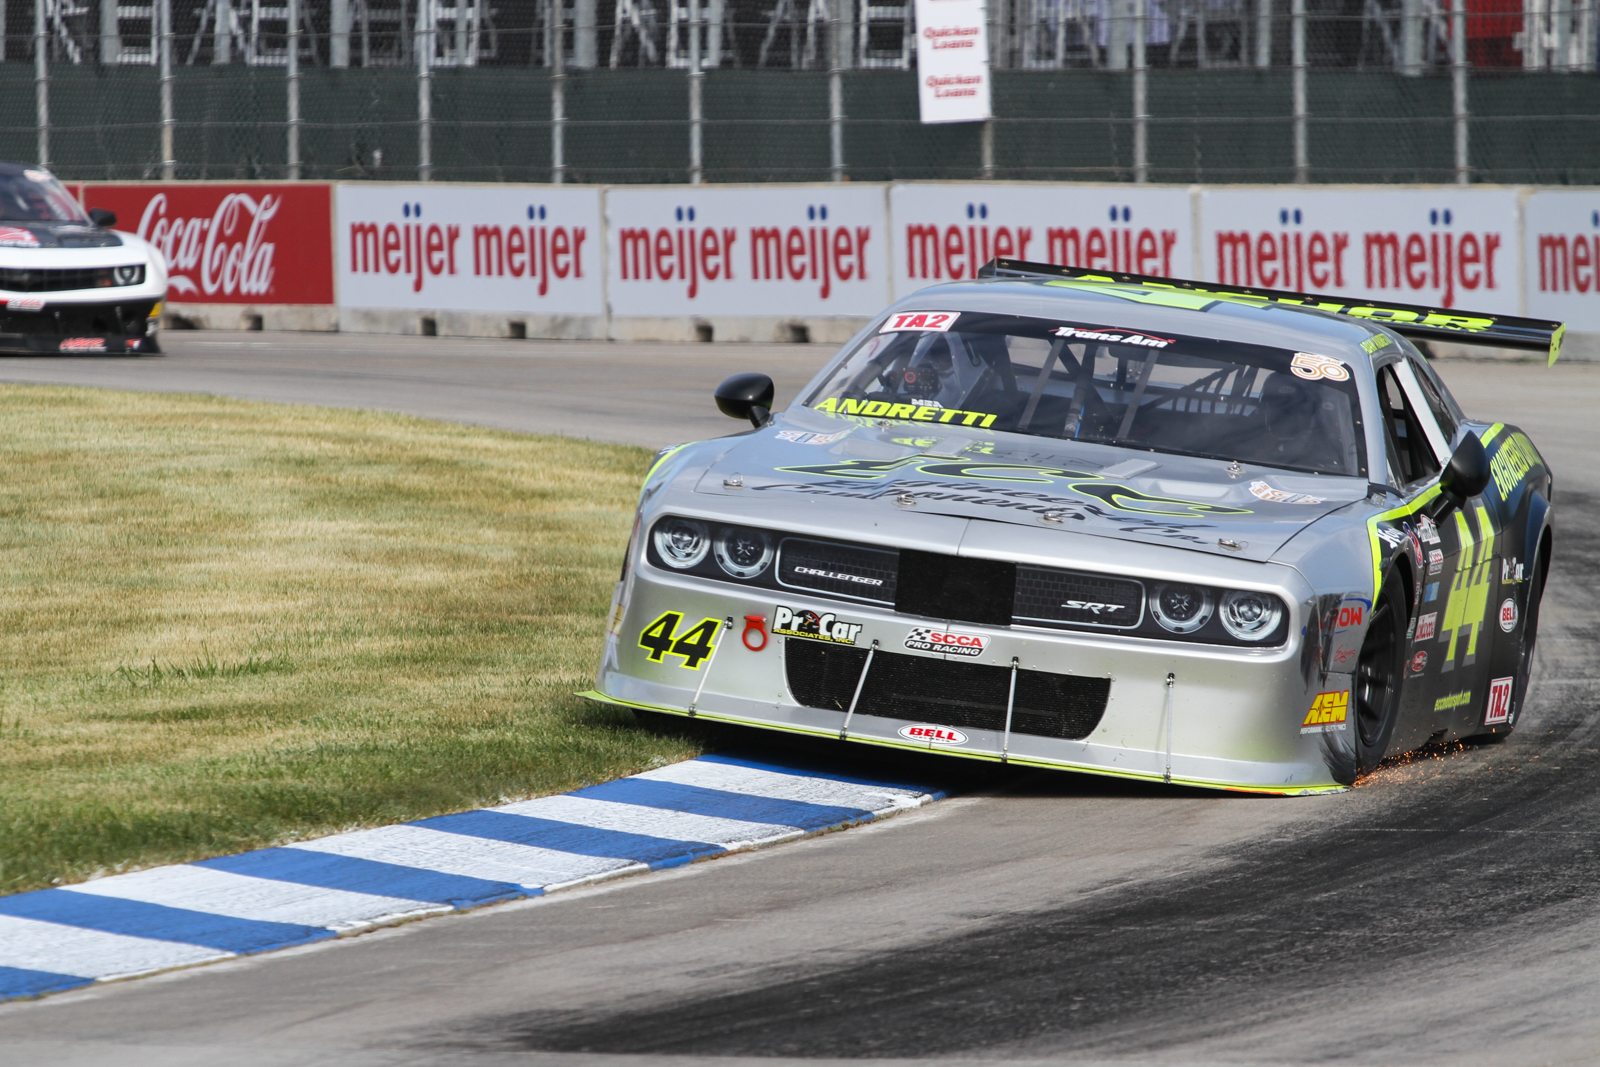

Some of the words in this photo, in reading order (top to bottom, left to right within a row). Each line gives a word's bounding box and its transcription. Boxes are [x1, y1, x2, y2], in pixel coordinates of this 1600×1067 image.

[350, 203, 460, 293] meijer
[473, 205, 586, 296] meijer
[619, 206, 736, 299] meijer
[750, 204, 870, 299] meijer
[1215, 209, 1348, 293] meijer
[1364, 209, 1500, 309] meijer
[893, 314, 950, 328] TA2
[1055, 326, 1123, 341] Trans
[1121, 335, 1168, 348] Am
[814, 397, 997, 428] ANDRETTI
[794, 566, 883, 587] CHALLENGER
[1061, 600, 1126, 615] SRT
[638, 610, 722, 670] 44
[906, 640, 931, 650] PRO
[934, 643, 981, 656] RACING
[930, 632, 983, 648] SCCA
[1490, 683, 1510, 719] TA2
[909, 727, 957, 741] BELL
